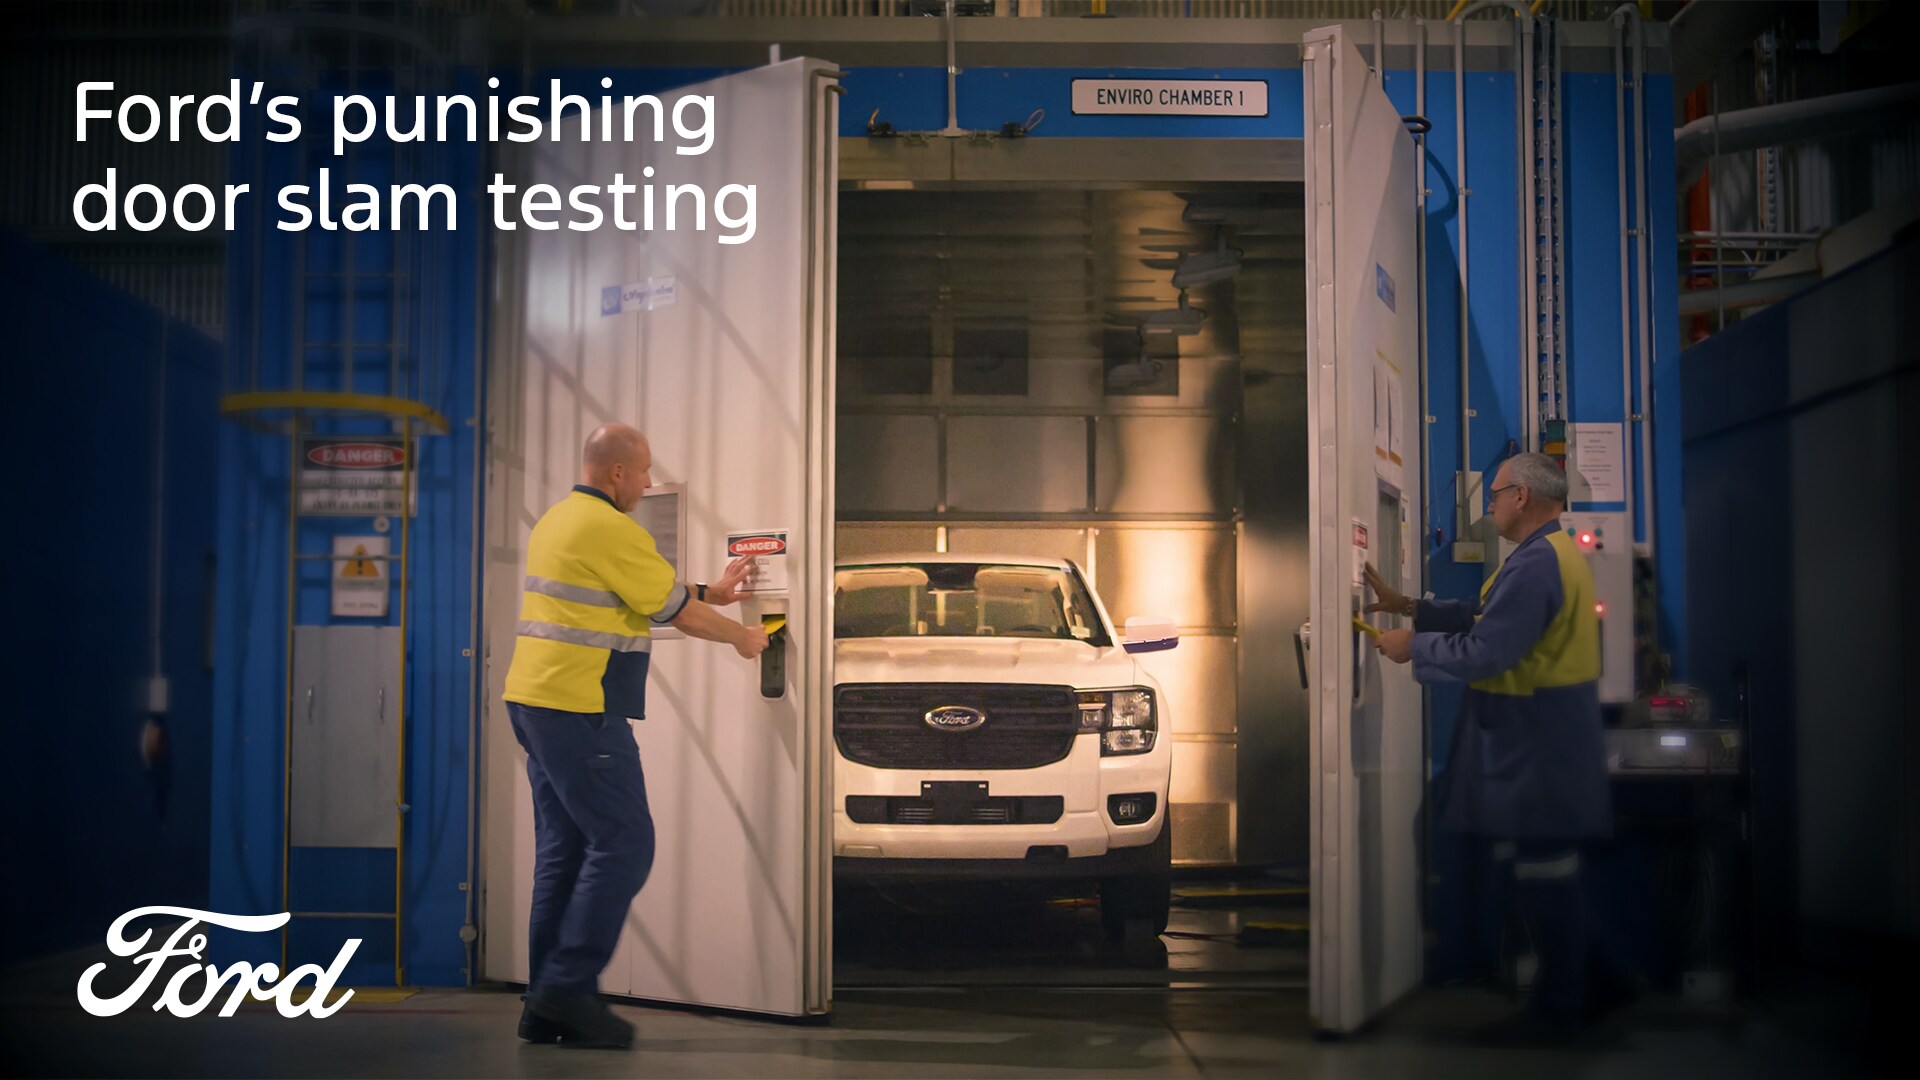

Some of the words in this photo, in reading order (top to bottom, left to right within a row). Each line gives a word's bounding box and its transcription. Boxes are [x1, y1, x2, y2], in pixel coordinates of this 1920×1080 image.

[1097, 88, 1154, 105] ENVIRO
[1159, 89, 1233, 106] CHAMBER
[1239, 90, 1244, 106] 1
[323, 449, 394, 463] DANGER
[736, 541, 778, 552] DANGER
[939, 711, 971, 725] Ford
